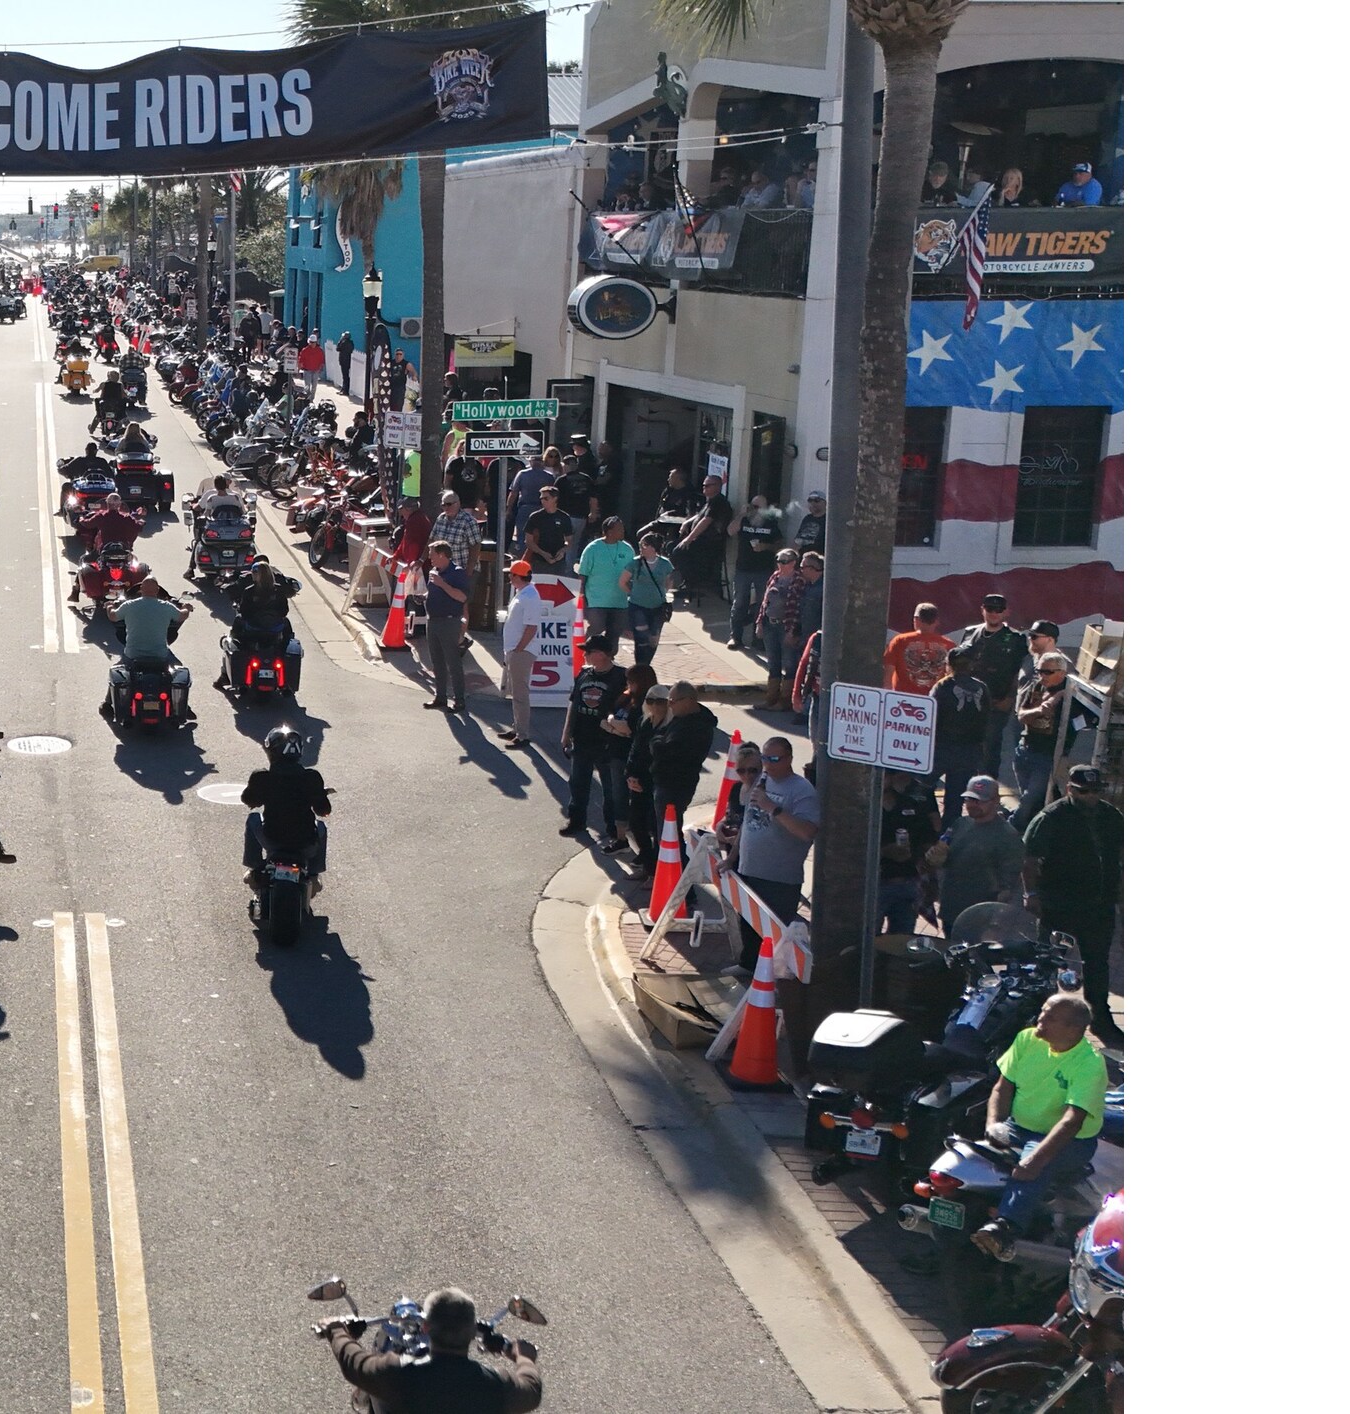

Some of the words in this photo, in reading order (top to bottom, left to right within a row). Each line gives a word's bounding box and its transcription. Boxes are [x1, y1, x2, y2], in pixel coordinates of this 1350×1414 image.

[433, 63, 459, 95] BIKE
[460, 57, 495, 88] WEEK
[135, 68, 313, 147] RIDERS
[984, 232, 1022, 257] AW
[1025, 230, 1111, 256] TIGERS
[983, 262, 1039, 272] OTORCYCLE
[1042, 261, 1085, 271] LAWYERS
[462, 402, 532, 418] Hollywood
[473, 439, 494, 449] ONE
[498, 439, 520, 449] WAY
[903, 454, 928, 470] EN
[541, 622, 568, 639] KE
[540, 644, 570, 656] KING
[848, 692, 866, 708] NO
[834, 706, 877, 727] PARKING
[845, 723, 864, 735] ANY
[884, 720, 931, 737] PARKING
[844, 734, 865, 747] TIME
[892, 739, 920, 752] ONLY
